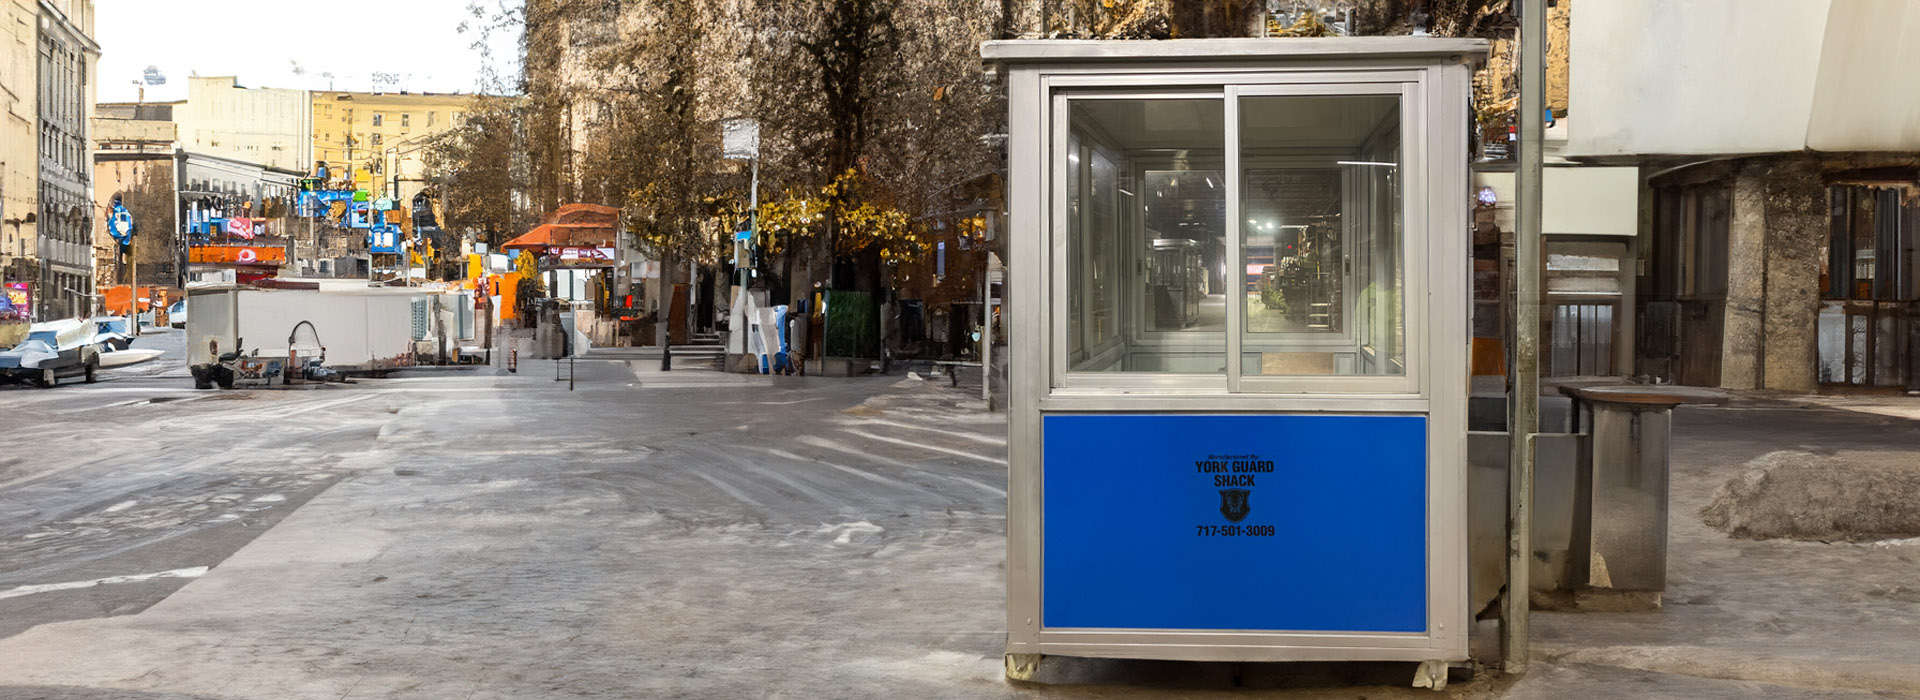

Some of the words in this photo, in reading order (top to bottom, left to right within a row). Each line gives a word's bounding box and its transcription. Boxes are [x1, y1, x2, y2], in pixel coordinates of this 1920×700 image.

[1195, 460, 1228, 473] YORK
[1232, 460, 1274, 473] GUARD
[1214, 474, 1255, 487] SHACK
[1196, 525, 1275, 537] 717-501-3009
